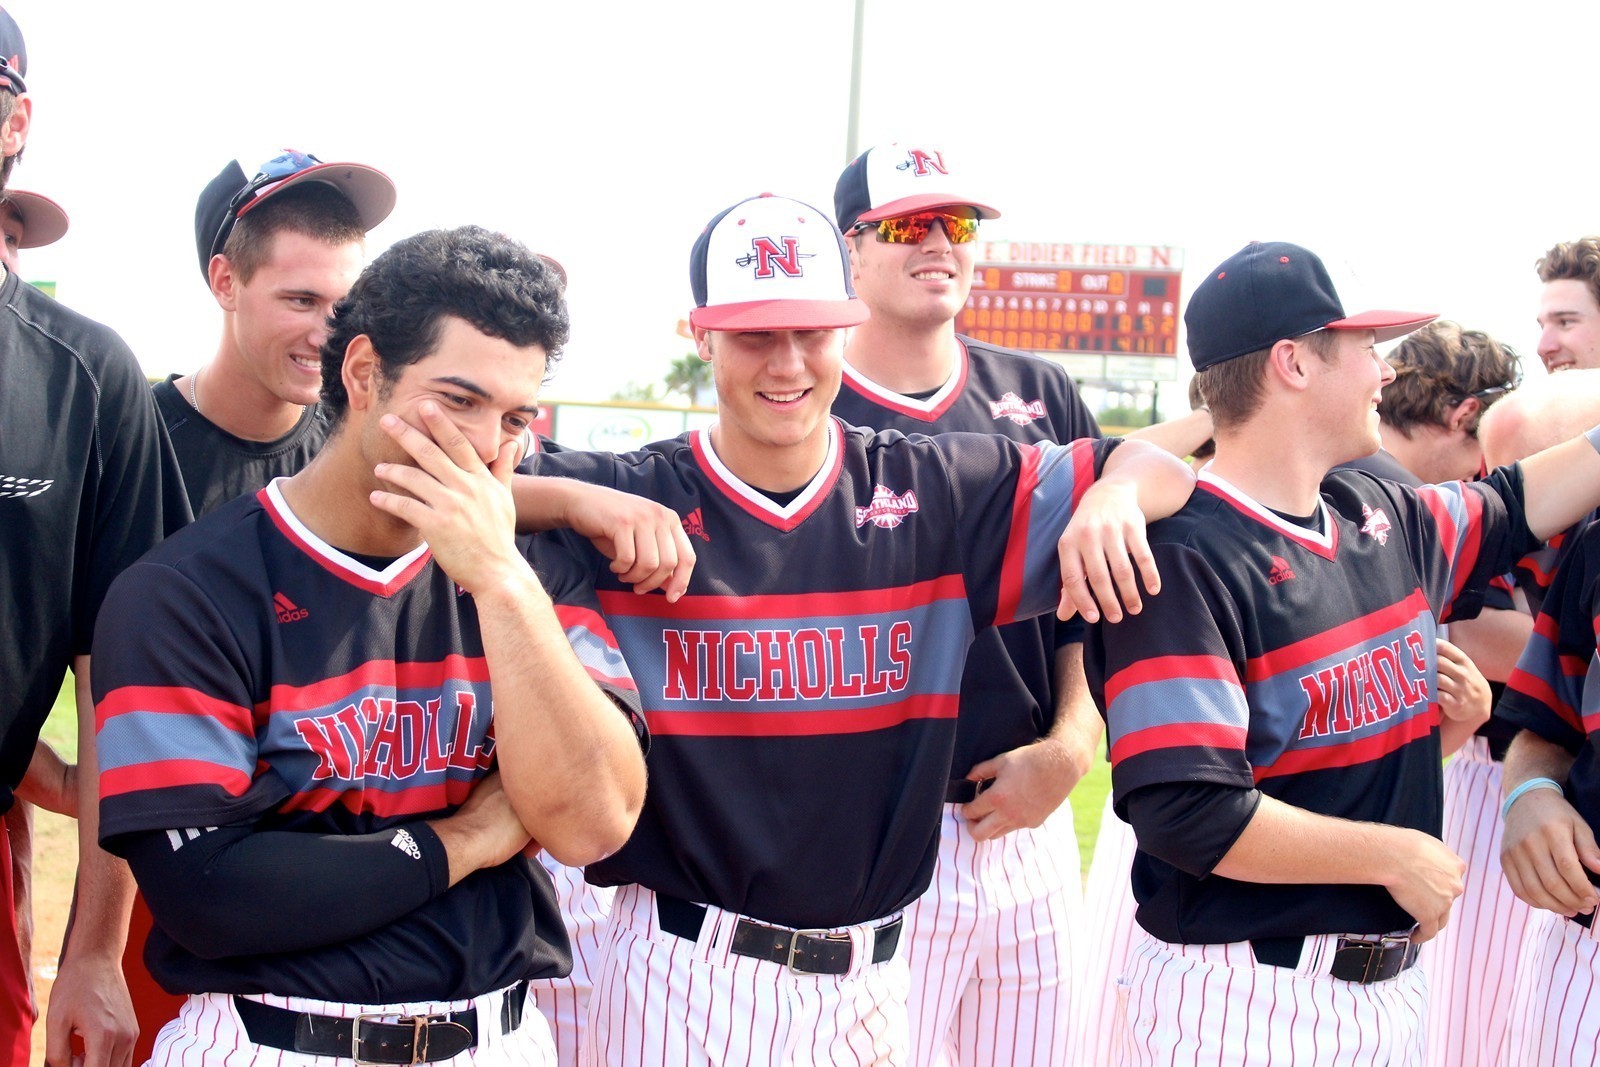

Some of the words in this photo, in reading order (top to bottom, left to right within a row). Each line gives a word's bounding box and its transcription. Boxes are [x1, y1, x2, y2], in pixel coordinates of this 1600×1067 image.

[908, 149, 949, 177] N
[752, 236, 803, 279] N
[1009, 242, 1074, 262] DIDIER
[1082, 244, 1136, 264] FIELD
[1150, 246, 1171, 266] N
[1012, 272, 1057, 288] STRIKE
[1081, 274, 1109, 291] OUT
[855, 491, 917, 524] SOTHLAND
[663, 620, 912, 702] NICHOLLS
[1298, 629, 1429, 740] NICHOLS
